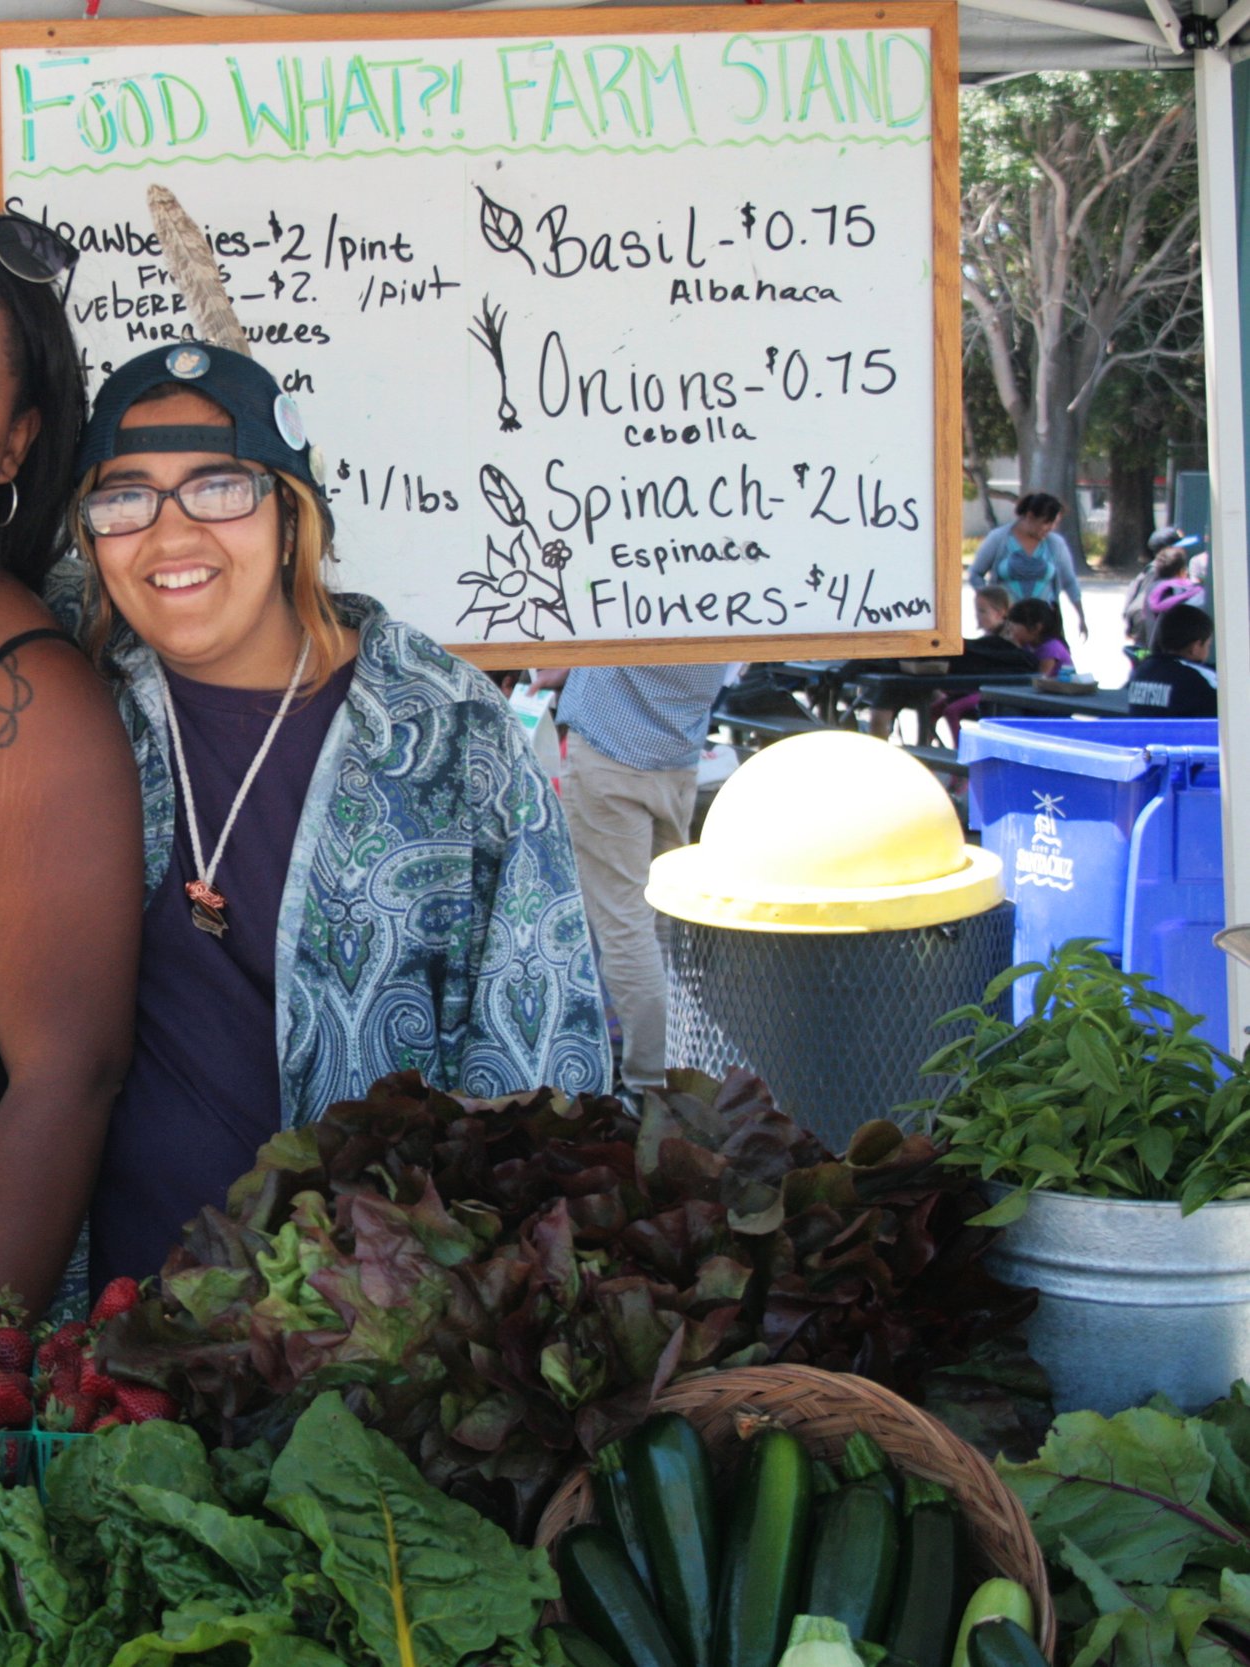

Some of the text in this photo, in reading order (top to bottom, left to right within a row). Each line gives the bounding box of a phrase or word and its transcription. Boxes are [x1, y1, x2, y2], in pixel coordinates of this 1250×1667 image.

[14, 56, 208, 161] FOOD
[496, 40, 699, 142] FARM
[721, 31, 932, 128] STAND
